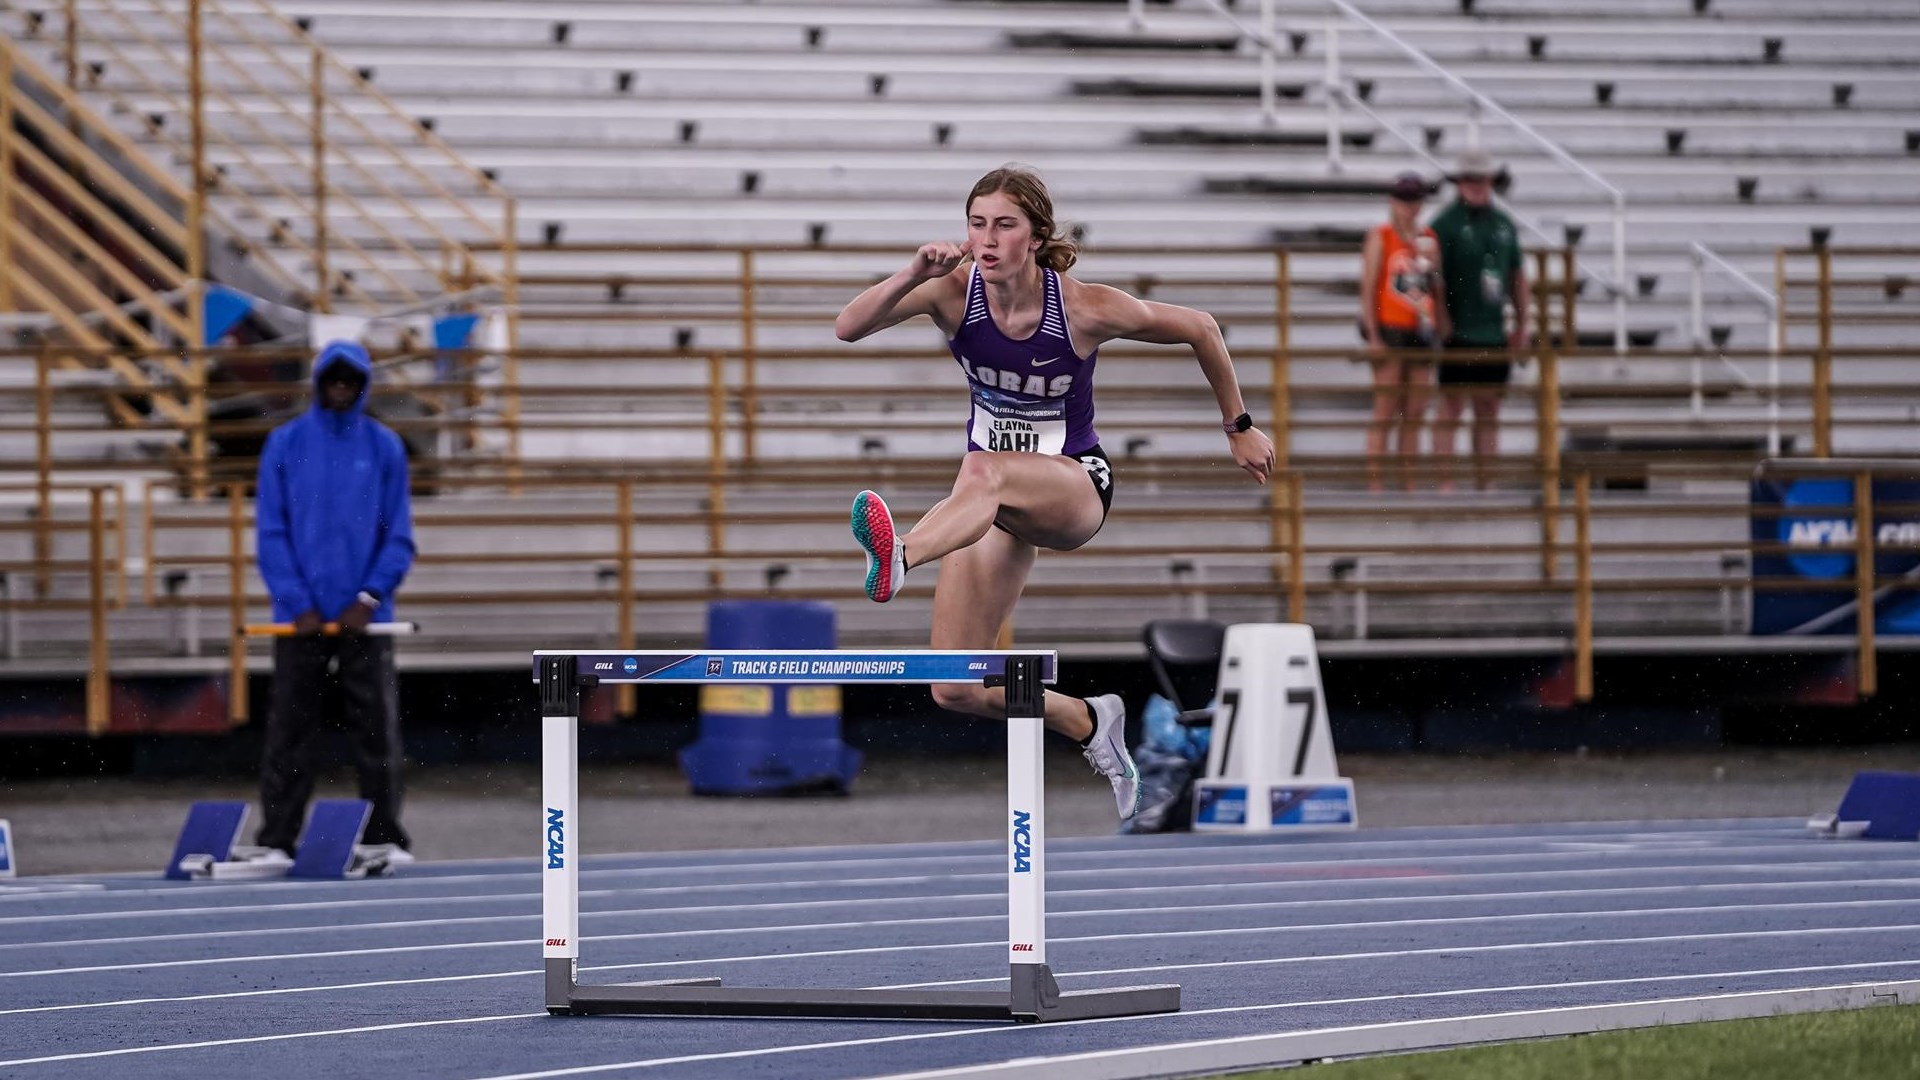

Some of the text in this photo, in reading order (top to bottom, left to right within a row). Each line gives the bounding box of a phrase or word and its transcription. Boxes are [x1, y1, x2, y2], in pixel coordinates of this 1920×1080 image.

[962, 355, 1073, 397] LORAS
[994, 420, 1033, 431] ELAYNA
[732, 661, 906, 674] TRACK & FIELD CHAMPIONSHIPS
[969, 662, 988, 670] GILL
[1219, 690, 1241, 776] 7
[1287, 688, 1316, 776] 7
[547, 807, 564, 870] NCAA
[1013, 810, 1031, 873] NCAA
[546, 938, 567, 946] GILL
[1011, 943, 1034, 952] GILL
